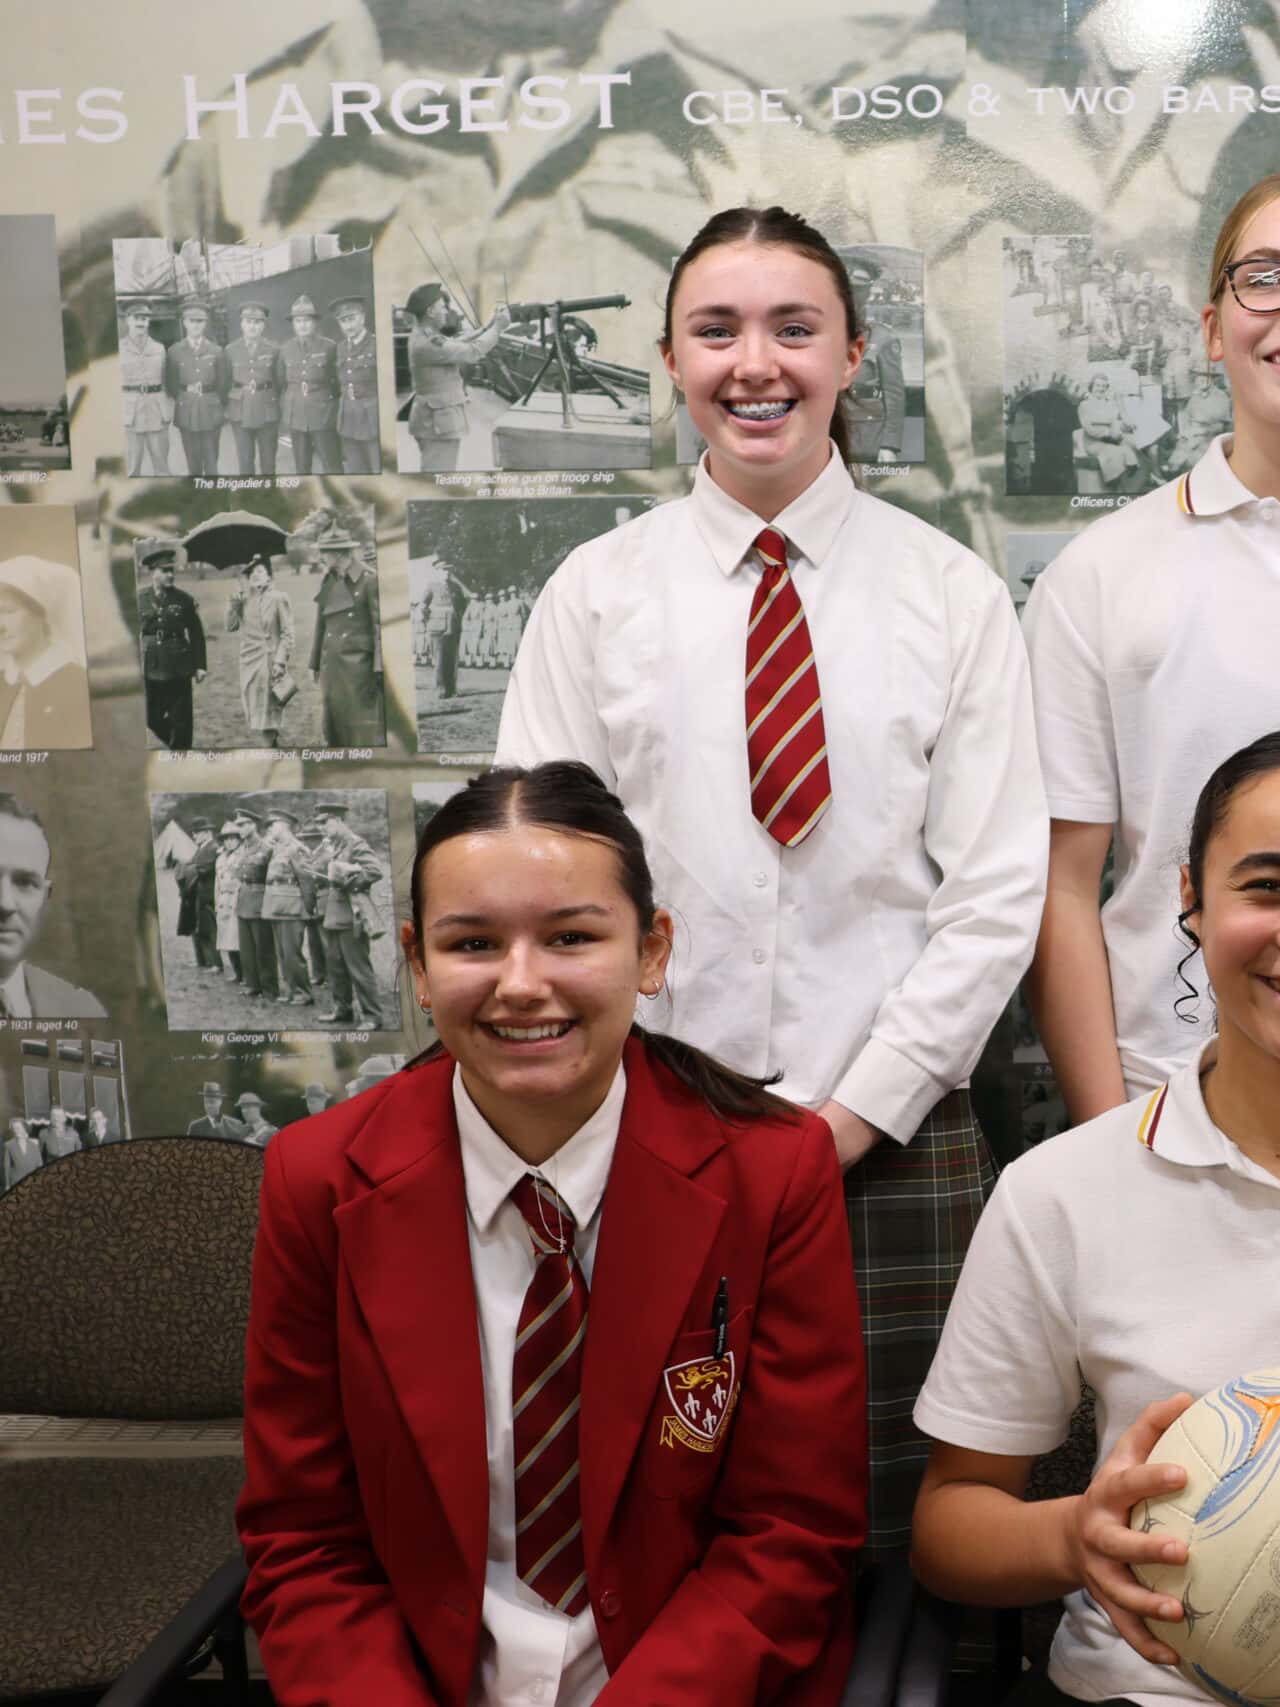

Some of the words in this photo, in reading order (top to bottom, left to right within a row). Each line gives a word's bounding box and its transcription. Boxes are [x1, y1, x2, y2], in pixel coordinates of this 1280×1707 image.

[0, 87, 129, 145] ES
[182, 71, 632, 141] HARGEST
[683, 88, 804, 128] CBE,
[831, 83, 943, 121] DSO
[967, 83, 1000, 118] &
[1027, 85, 1136, 115] TWO
[861, 464, 911, 477] Scotland
[194, 477, 214, 488] The
[434, 473, 472, 487] Testing
[521, 475, 543, 487] gun
[545, 474, 559, 484] on
[561, 471, 590, 485] troop
[592, 471, 615, 484] ship
[523, 486, 535, 497] to
[1070, 495, 1114, 507] Officers
[25, 751, 49, 763] 1917
[301, 749, 344, 763] England
[347, 748, 373, 760] 1940
[10, 1020, 33, 1031] 1931
[36, 1019, 62, 1033] aged
[64, 1019, 79, 1031] 40
[200, 1032, 224, 1045] King
[226, 1032, 265, 1045] George
[267, 1032, 279, 1042] VI
[344, 1032, 369, 1043] 1940
